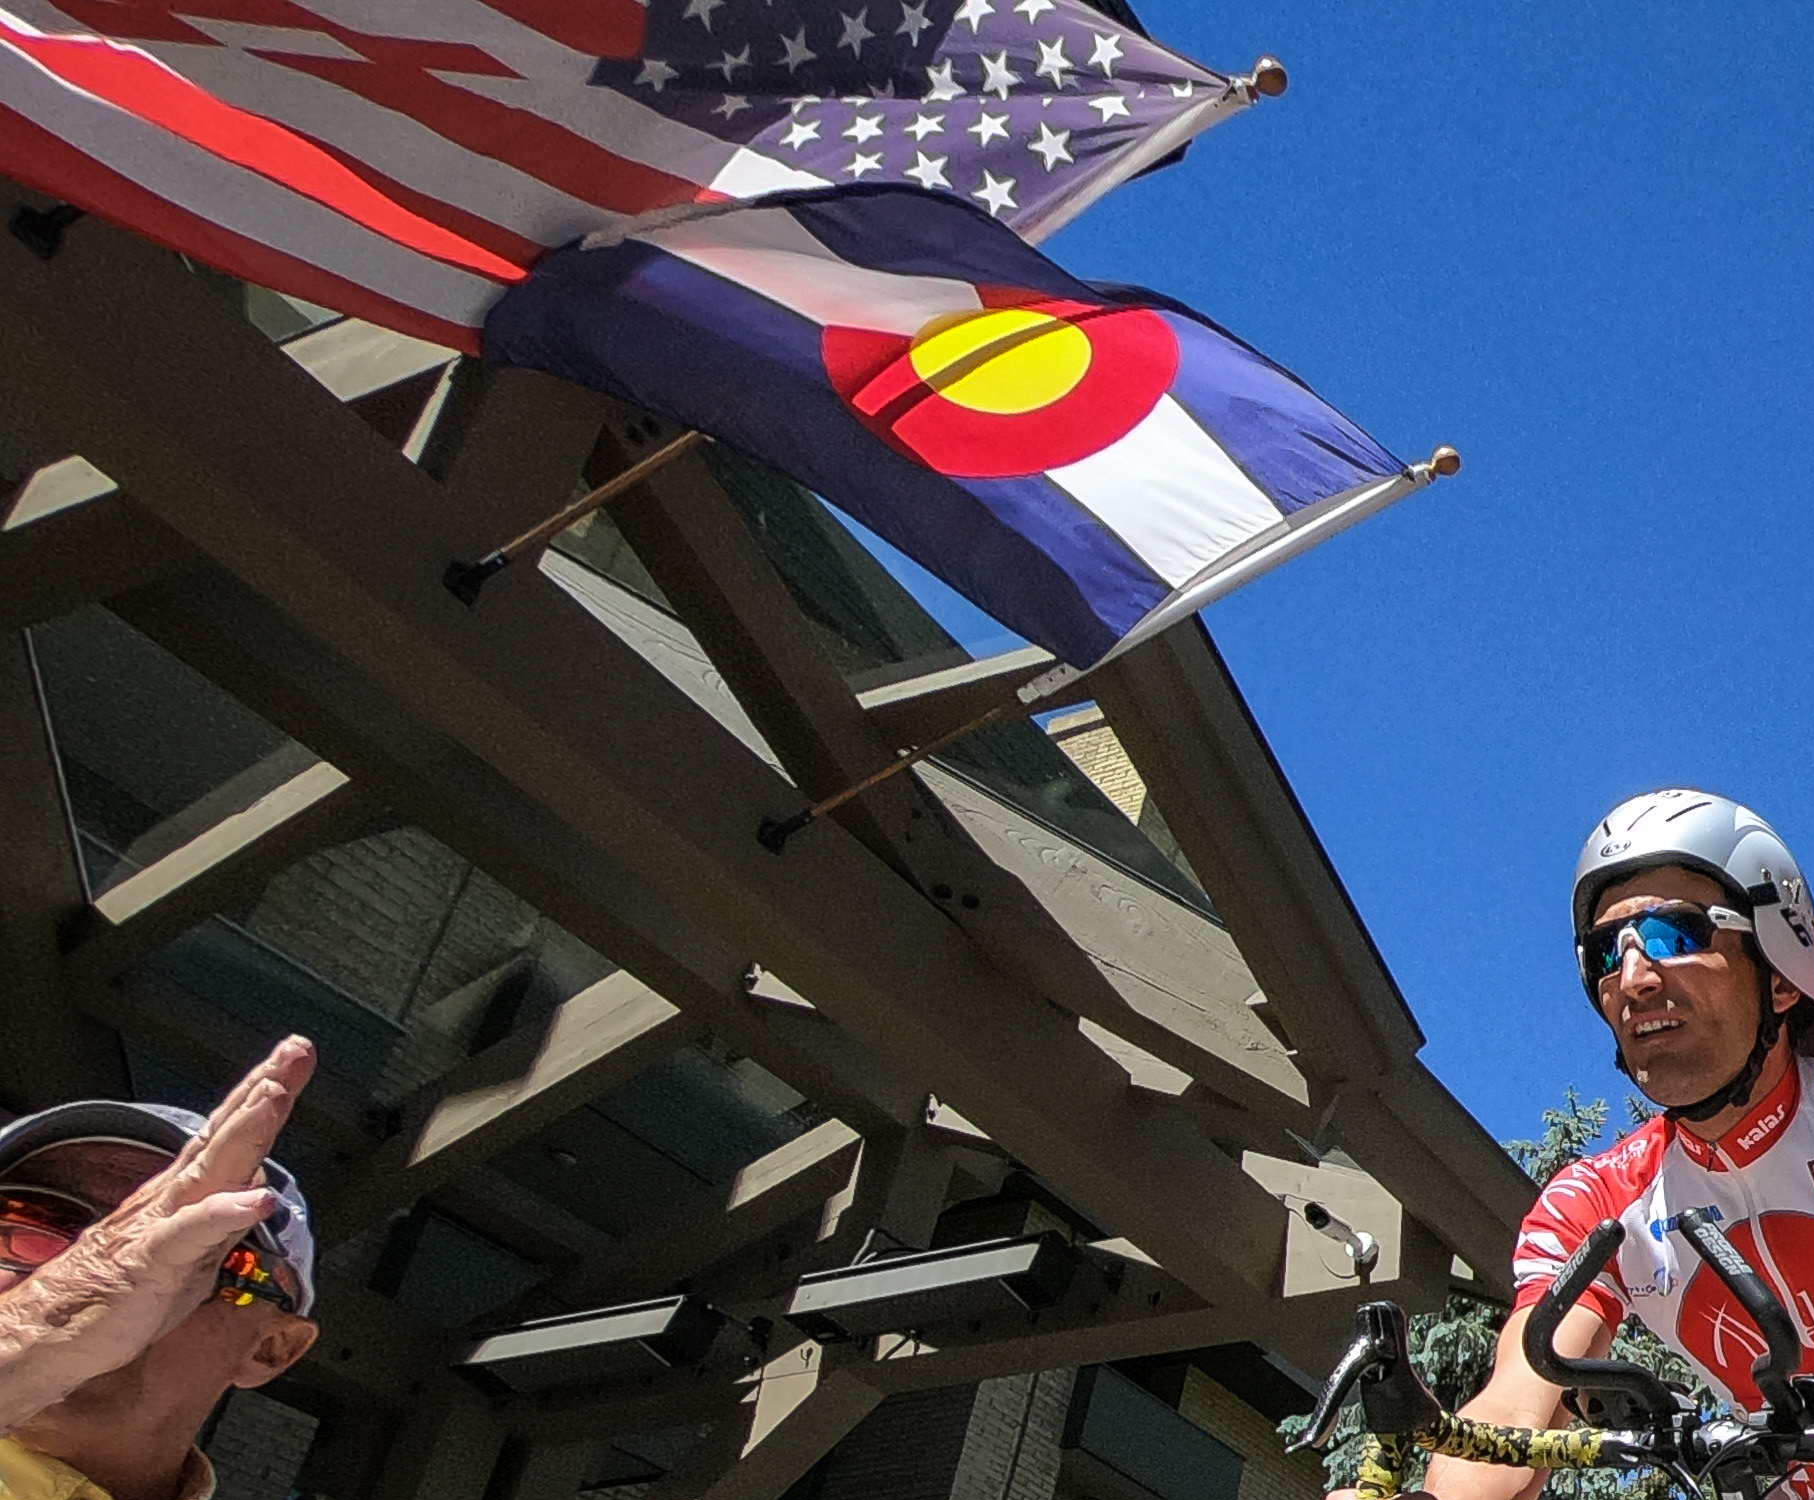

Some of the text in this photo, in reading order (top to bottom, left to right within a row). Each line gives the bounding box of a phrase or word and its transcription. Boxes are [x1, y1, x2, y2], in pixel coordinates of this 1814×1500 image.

[1737, 1104, 1785, 1150] kalas
[1552, 1241, 1591, 1296] DESIGN
[1694, 1228, 1741, 1276] DESIGN
